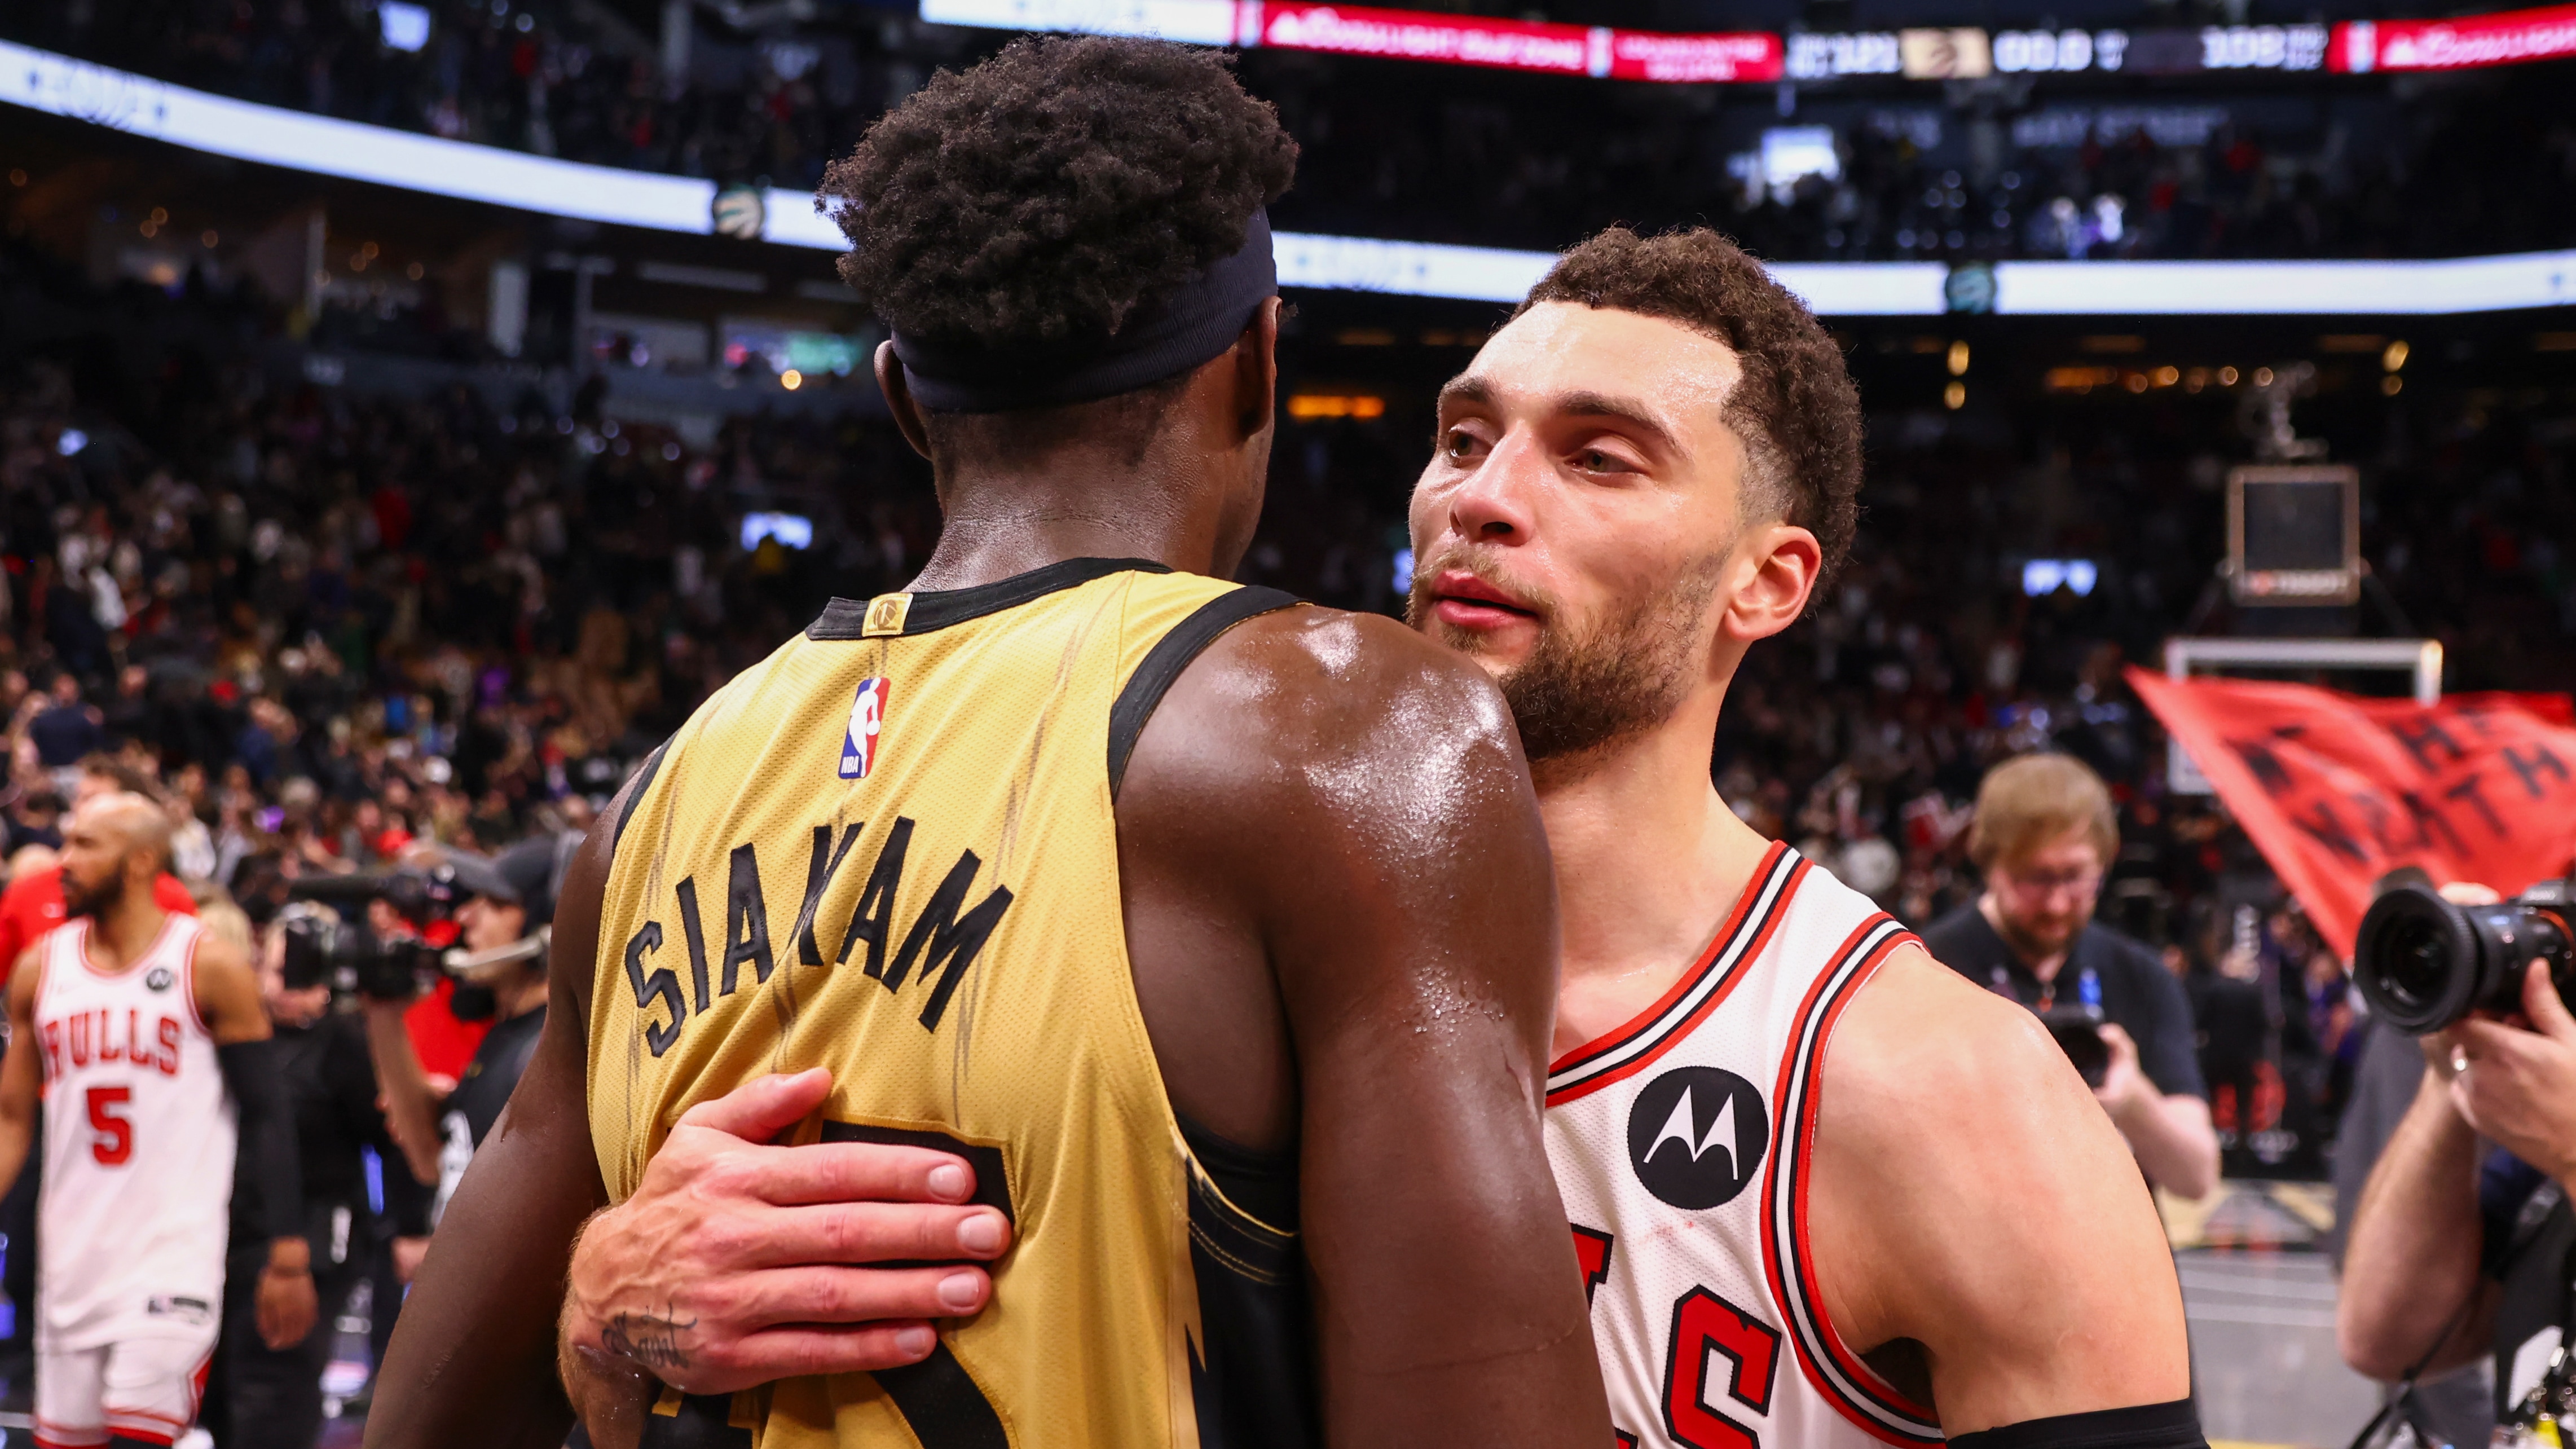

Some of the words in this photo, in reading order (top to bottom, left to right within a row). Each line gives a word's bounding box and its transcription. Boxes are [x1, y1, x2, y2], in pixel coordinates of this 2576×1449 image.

[841, 756, 859, 774] NBA
[624, 815, 1014, 1059] SIAKAM
[86, 1086, 133, 1167] 5
